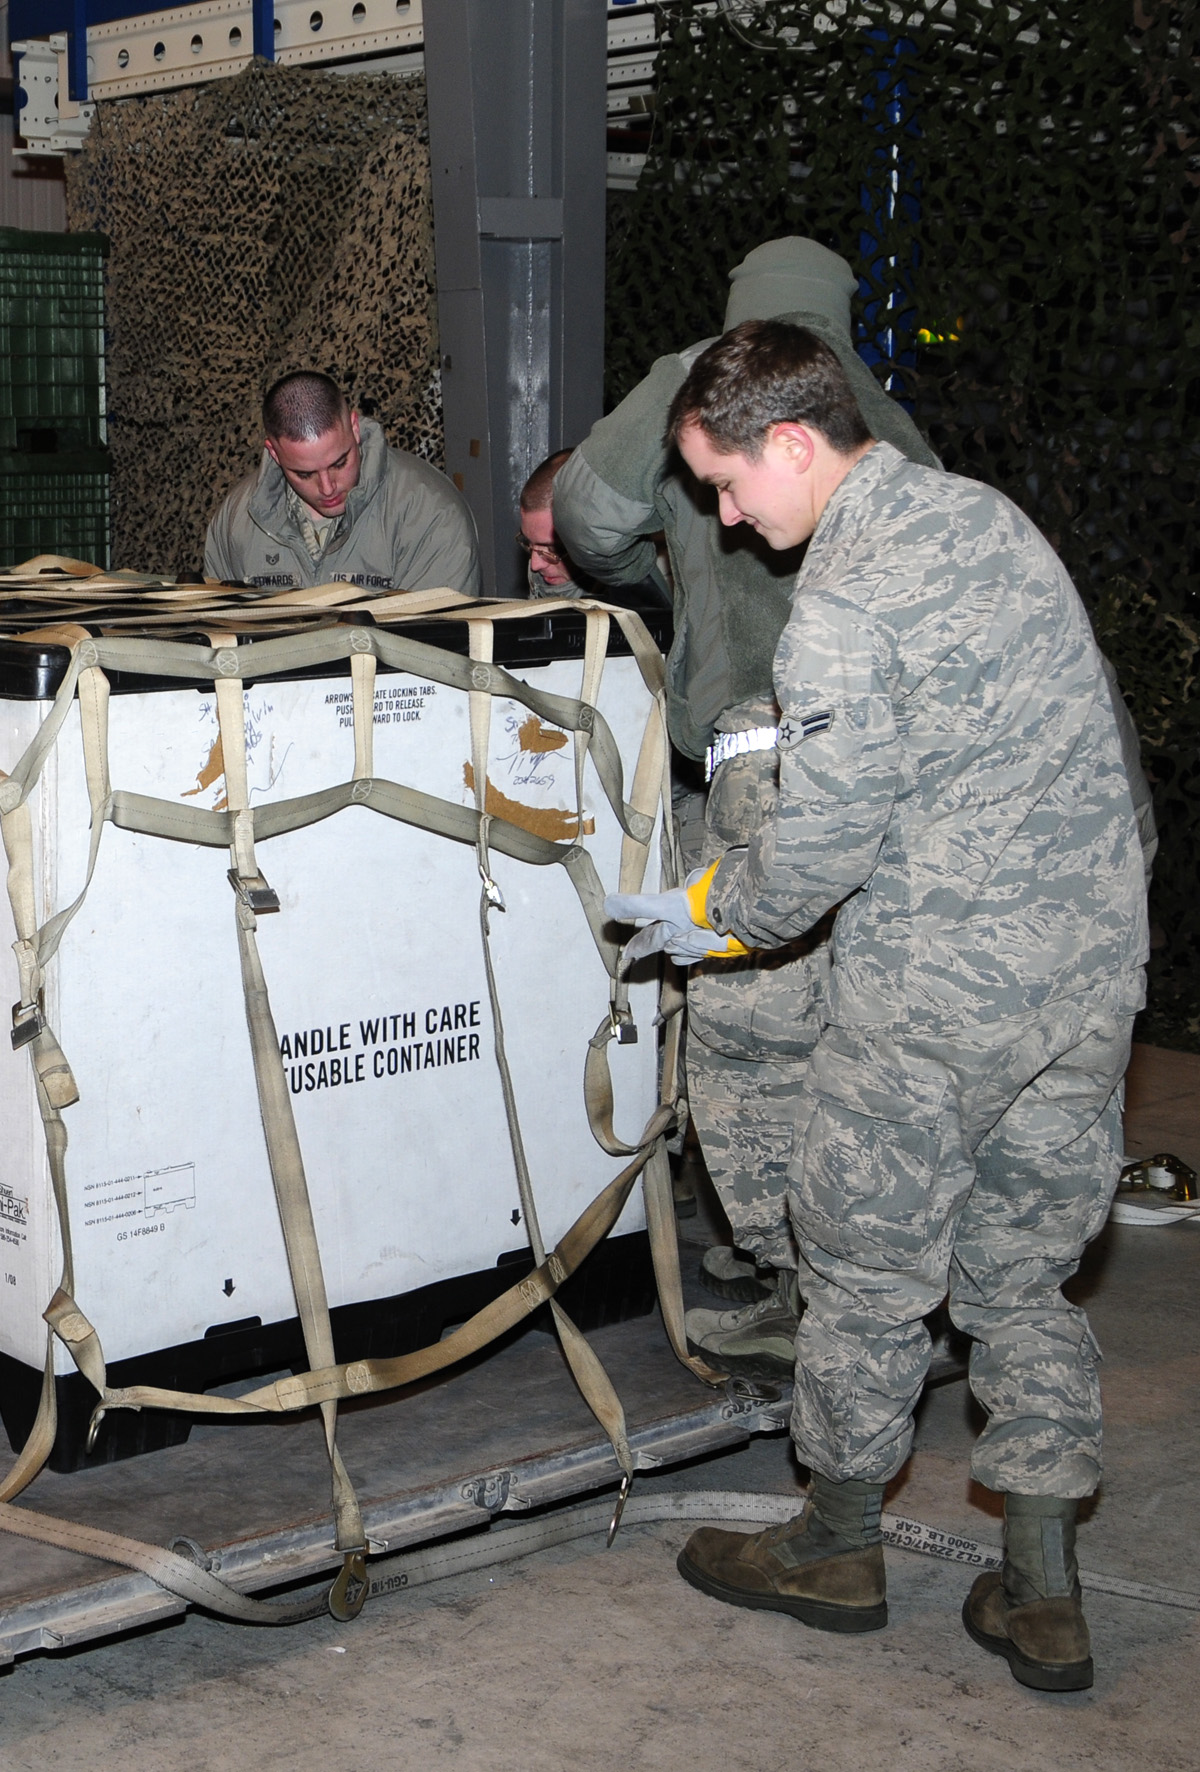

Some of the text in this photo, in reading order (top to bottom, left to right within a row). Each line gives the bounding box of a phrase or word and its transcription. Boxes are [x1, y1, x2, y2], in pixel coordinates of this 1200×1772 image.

[351, 574, 365, 586] AIR
[366, 575, 393, 589] FORCE
[325, 692, 353, 704] ARROWS
[388, 687, 418, 699] LOCKING
[419, 685, 437, 696] TABS.
[385, 700, 394, 711] TO
[395, 698, 426, 710] RELEASE.
[392, 713, 401, 723] TO
[402, 710, 421, 722] LOCK.
[280, 1000, 481, 1060] ANDLE WITH CARE
[284, 1033, 481, 1094] USABLE CONTAINER
[116, 1231, 128, 1242] GS
[130, 1223, 159, 1238] 14F8849
[895, 1519, 979, 1551] 5000 LB. CAP.
[956, 1550, 982, 1563] CL2
[371, 1573, 409, 1594] CGU-1/B
